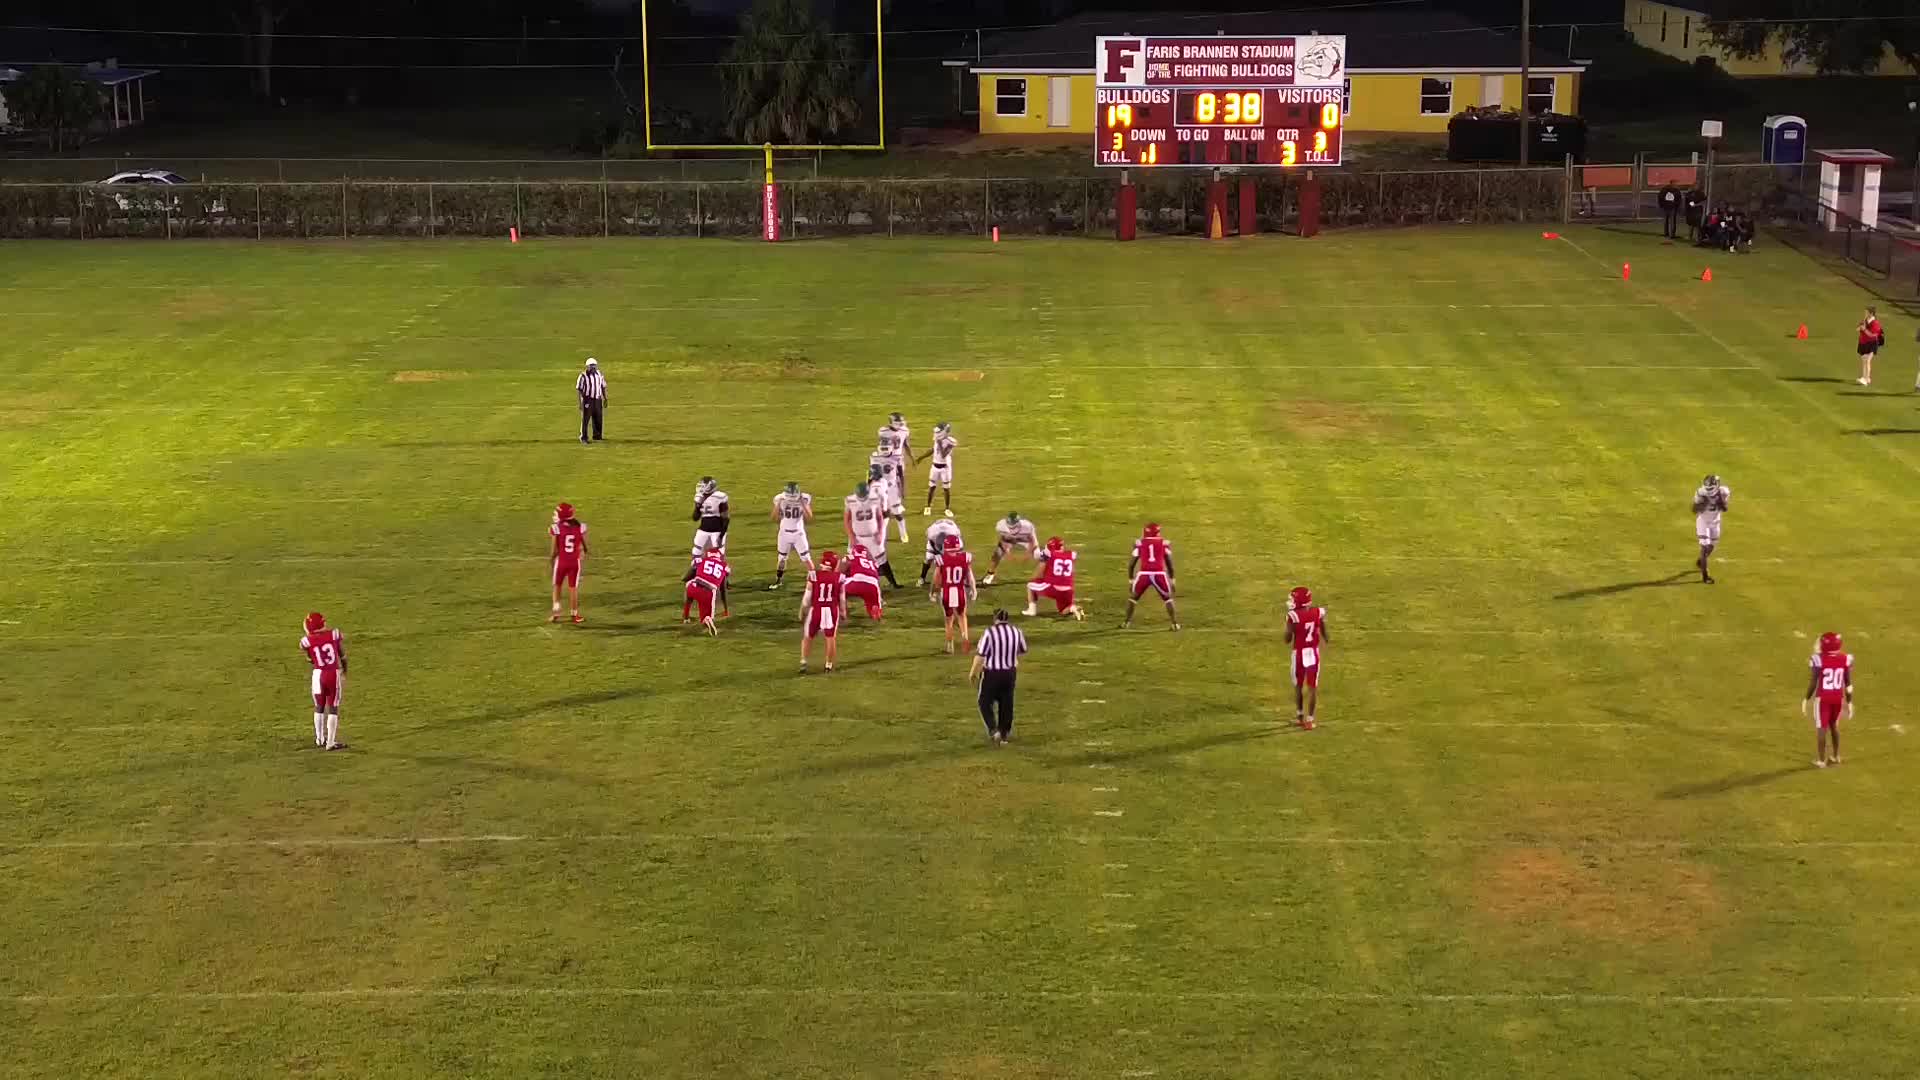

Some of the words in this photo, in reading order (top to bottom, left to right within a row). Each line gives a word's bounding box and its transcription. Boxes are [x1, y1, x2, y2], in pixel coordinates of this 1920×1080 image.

[1146, 46, 1180, 58] FARIS
[1183, 46, 1239, 58] BRANNEN
[1241, 45, 1295, 58] STADIUM
[1104, 40, 1141, 83] F
[1148, 63, 1170, 71] HOME
[1174, 64, 1228, 77] FIGHTING
[1231, 64, 1293, 77] BULLDOGS
[1146, 71, 1157, 79] OF
[1158, 71, 1172, 79] THE
[1097, 89, 1170, 103] BULLDOGS
[1278, 89, 1341, 103] VISITORS
[1108, 104, 1132, 128] 19
[1197, 92, 1261, 123] 8:38
[1322, 103, 1339, 128] 0
[1112, 132, 1124, 151] 3
[1130, 129, 1166, 141] DOWN
[1176, 129, 1191, 141] TO
[1193, 129, 1210, 141] GO
[1224, 129, 1249, 141] BALL
[1250, 129, 1265, 141] ON
[1277, 129, 1299, 141] QTR
[1314, 131, 1327, 152] 3
[1281, 140, 1296, 165] 3
[564, 534, 576, 553] 5
[1148, 544, 1157, 563] 1
[703, 559, 723, 579] 56
[945, 566, 963, 584] 10
[1052, 558, 1073, 577] 63
[817, 583, 833, 602] 11
[1304, 621, 1316, 642] 7
[312, 643, 336, 667] 13
[1822, 667, 1845, 690] 20
